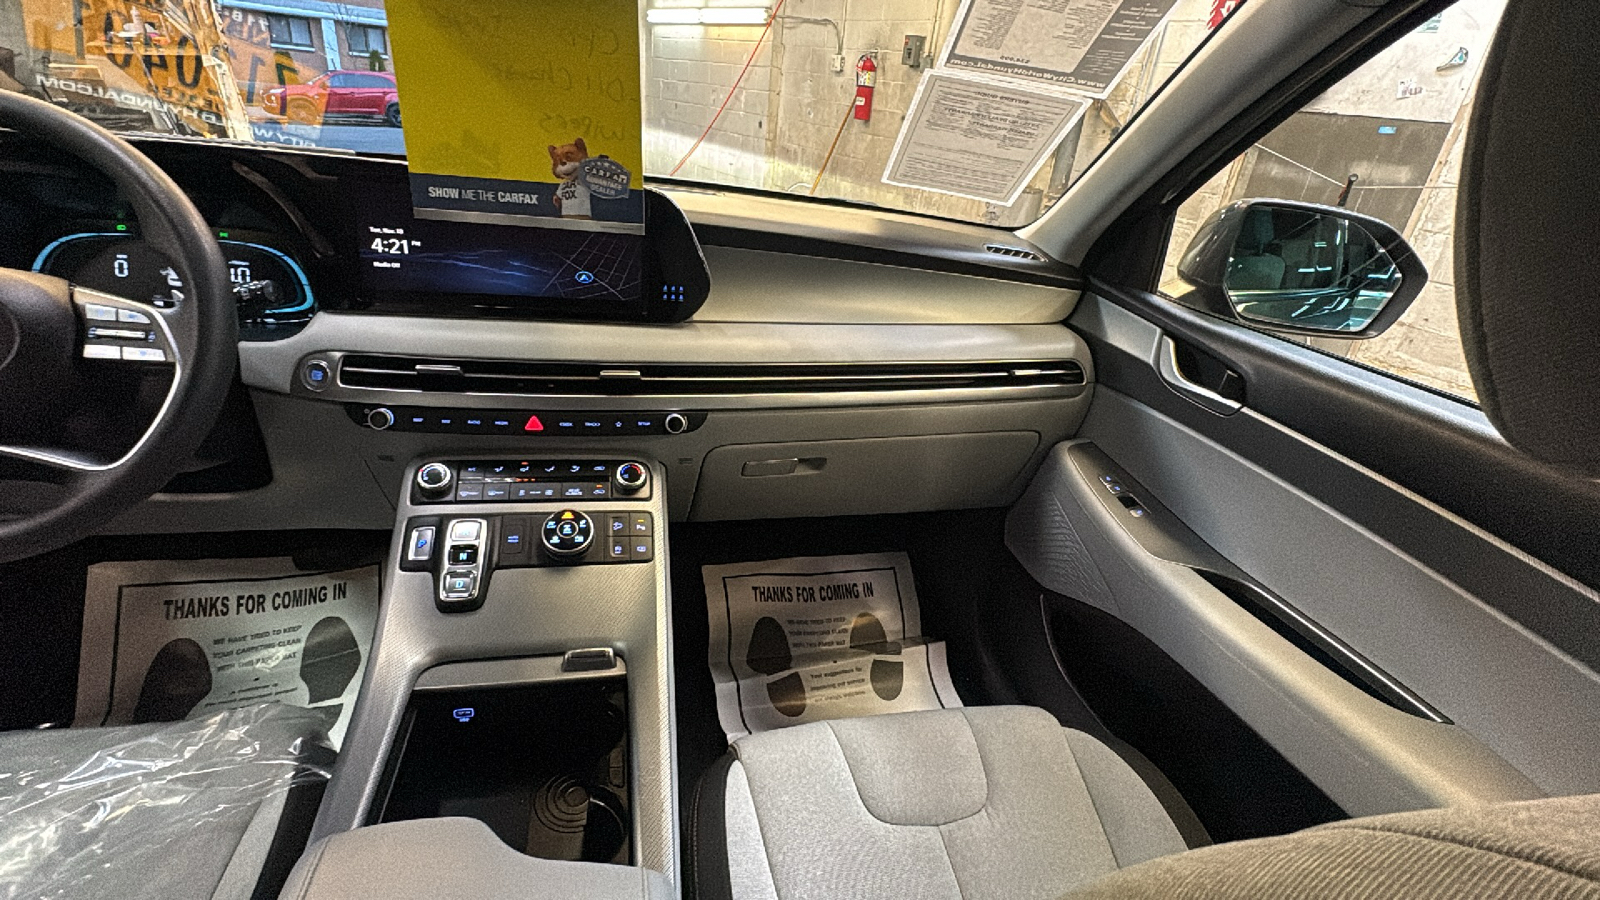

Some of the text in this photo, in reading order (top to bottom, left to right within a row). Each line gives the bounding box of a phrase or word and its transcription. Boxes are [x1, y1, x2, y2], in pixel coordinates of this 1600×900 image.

[584, 166, 628, 184] CARFAX
[427, 186, 539, 204] SHOW ME THE CARFAX
[371, 237, 409, 255] 4:21
[114, 259, 129, 278] 0
[418, 539, 427, 549] P
[459, 552, 468, 561] N
[455, 580, 465, 589] D
[752, 581, 874, 603] THANKS FOR COMING IN
[164, 582, 348, 621] THANKS FOR COMING IN
